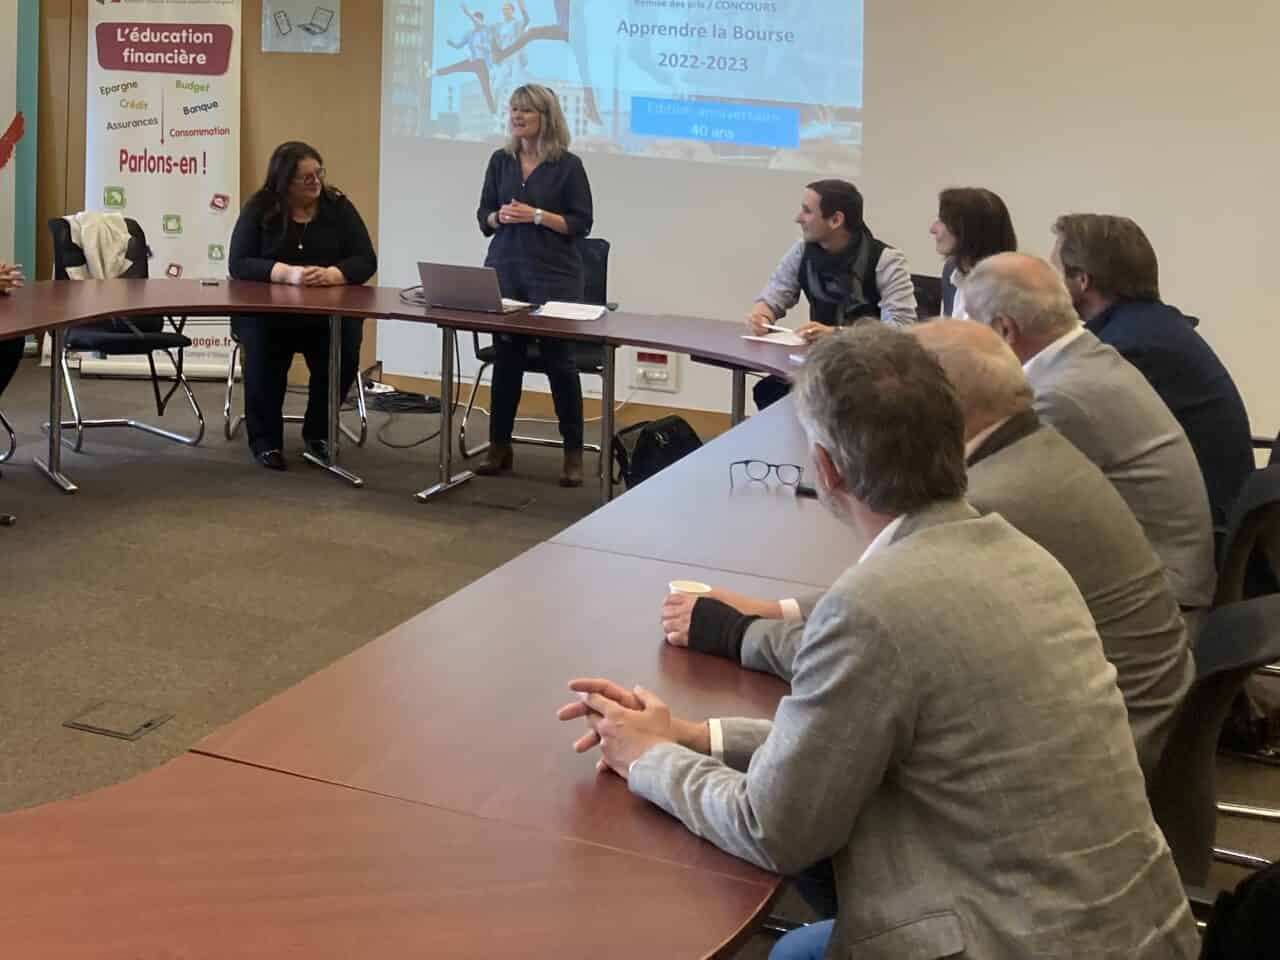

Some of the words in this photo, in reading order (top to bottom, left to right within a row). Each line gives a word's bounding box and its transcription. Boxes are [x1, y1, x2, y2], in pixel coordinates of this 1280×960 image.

[715, 0, 778, 13] CONCOURS
[116, 26, 214, 44] L'éducation
[616, 20, 708, 38] Apprendre
[712, 24, 728, 39] la
[733, 25, 795, 43] Bourse
[122, 47, 207, 65] financière
[656, 52, 749, 72] 2022-2023
[175, 79, 210, 93] Budget
[183, 100, 220, 115] Banque
[106, 117, 159, 131] Assurances
[169, 126, 231, 138] Consommation
[119, 148, 198, 175] Parlons-en
[202, 151, 207, 175] !
